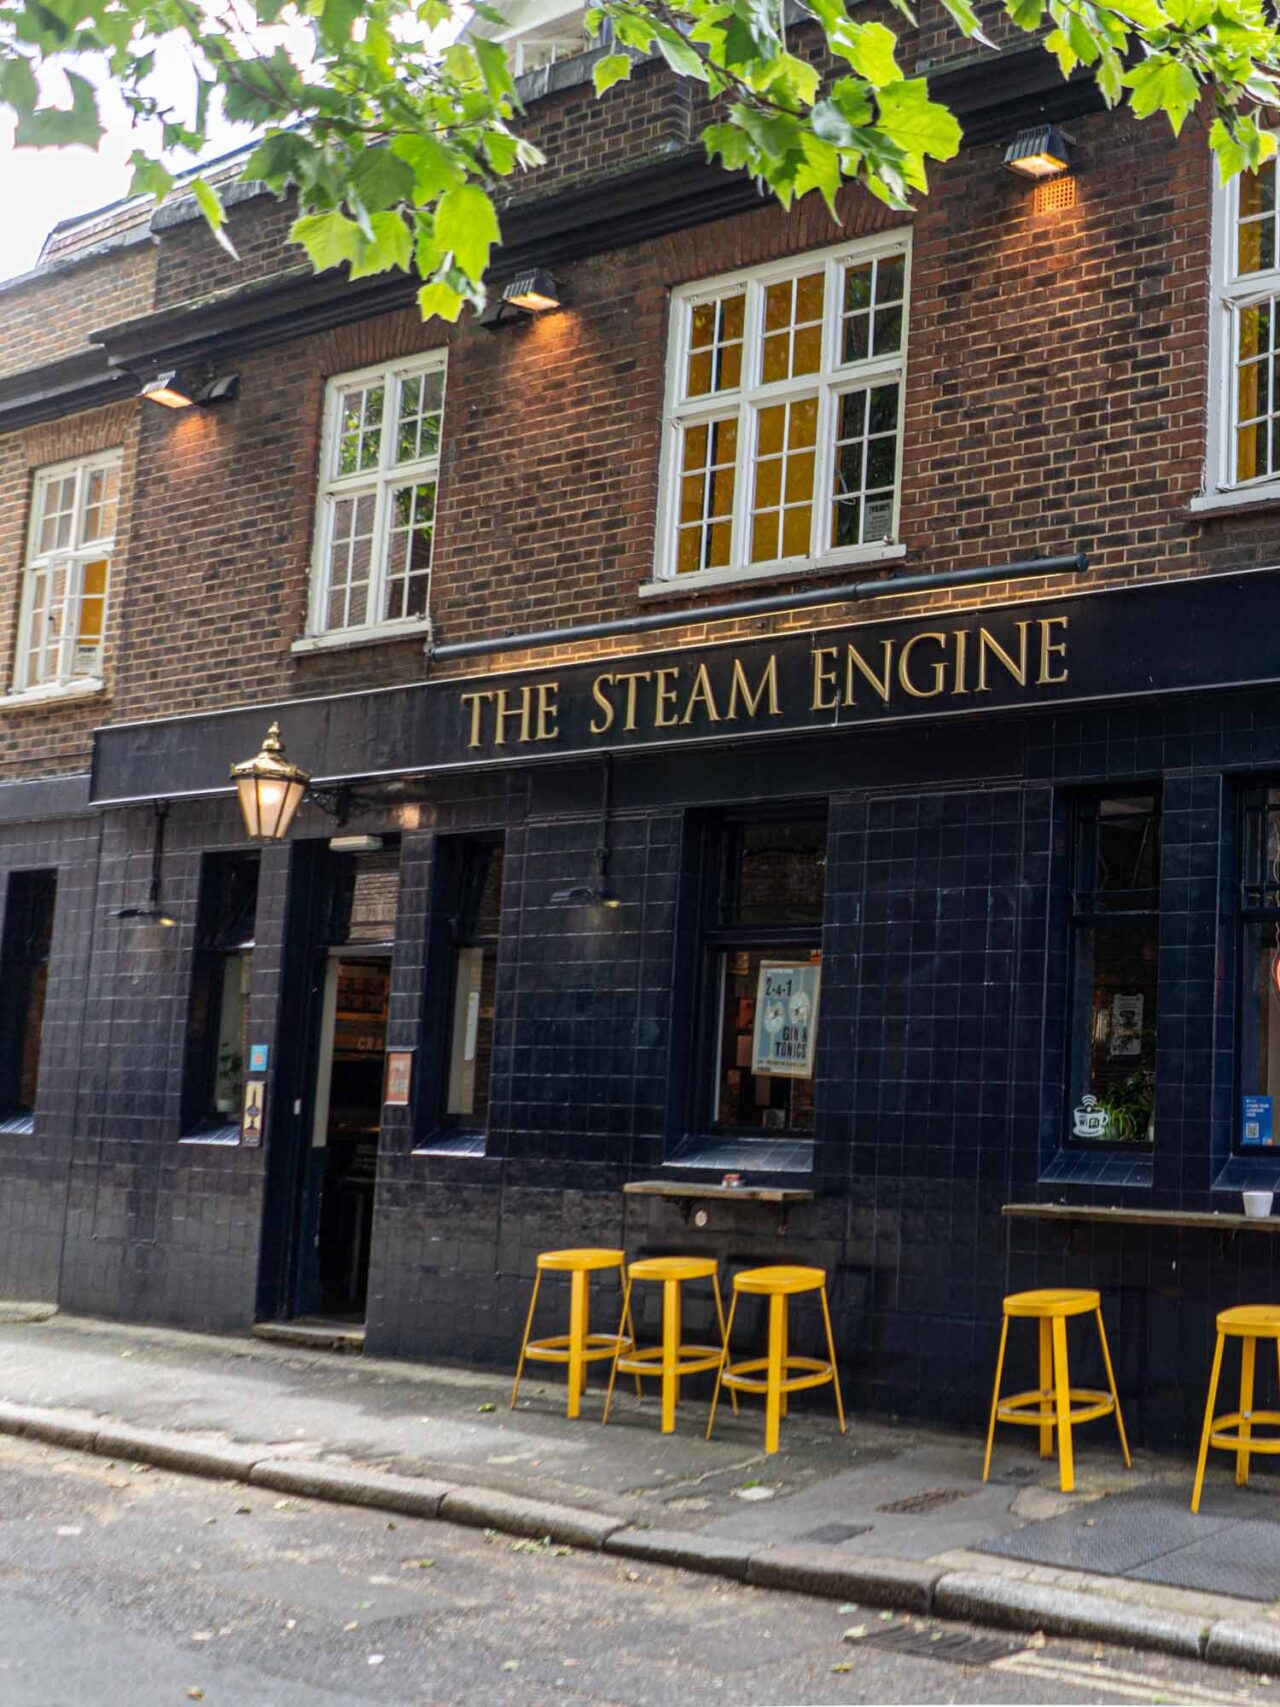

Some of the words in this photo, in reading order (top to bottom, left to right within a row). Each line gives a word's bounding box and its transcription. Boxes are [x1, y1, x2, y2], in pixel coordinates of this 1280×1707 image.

[461, 682, 560, 748] THE
[589, 654, 783, 735] STEAM
[810, 616, 1070, 711] ENGINE
[765, 978, 792, 997] 2-4-1
[783, 1025, 800, 1041] GIN
